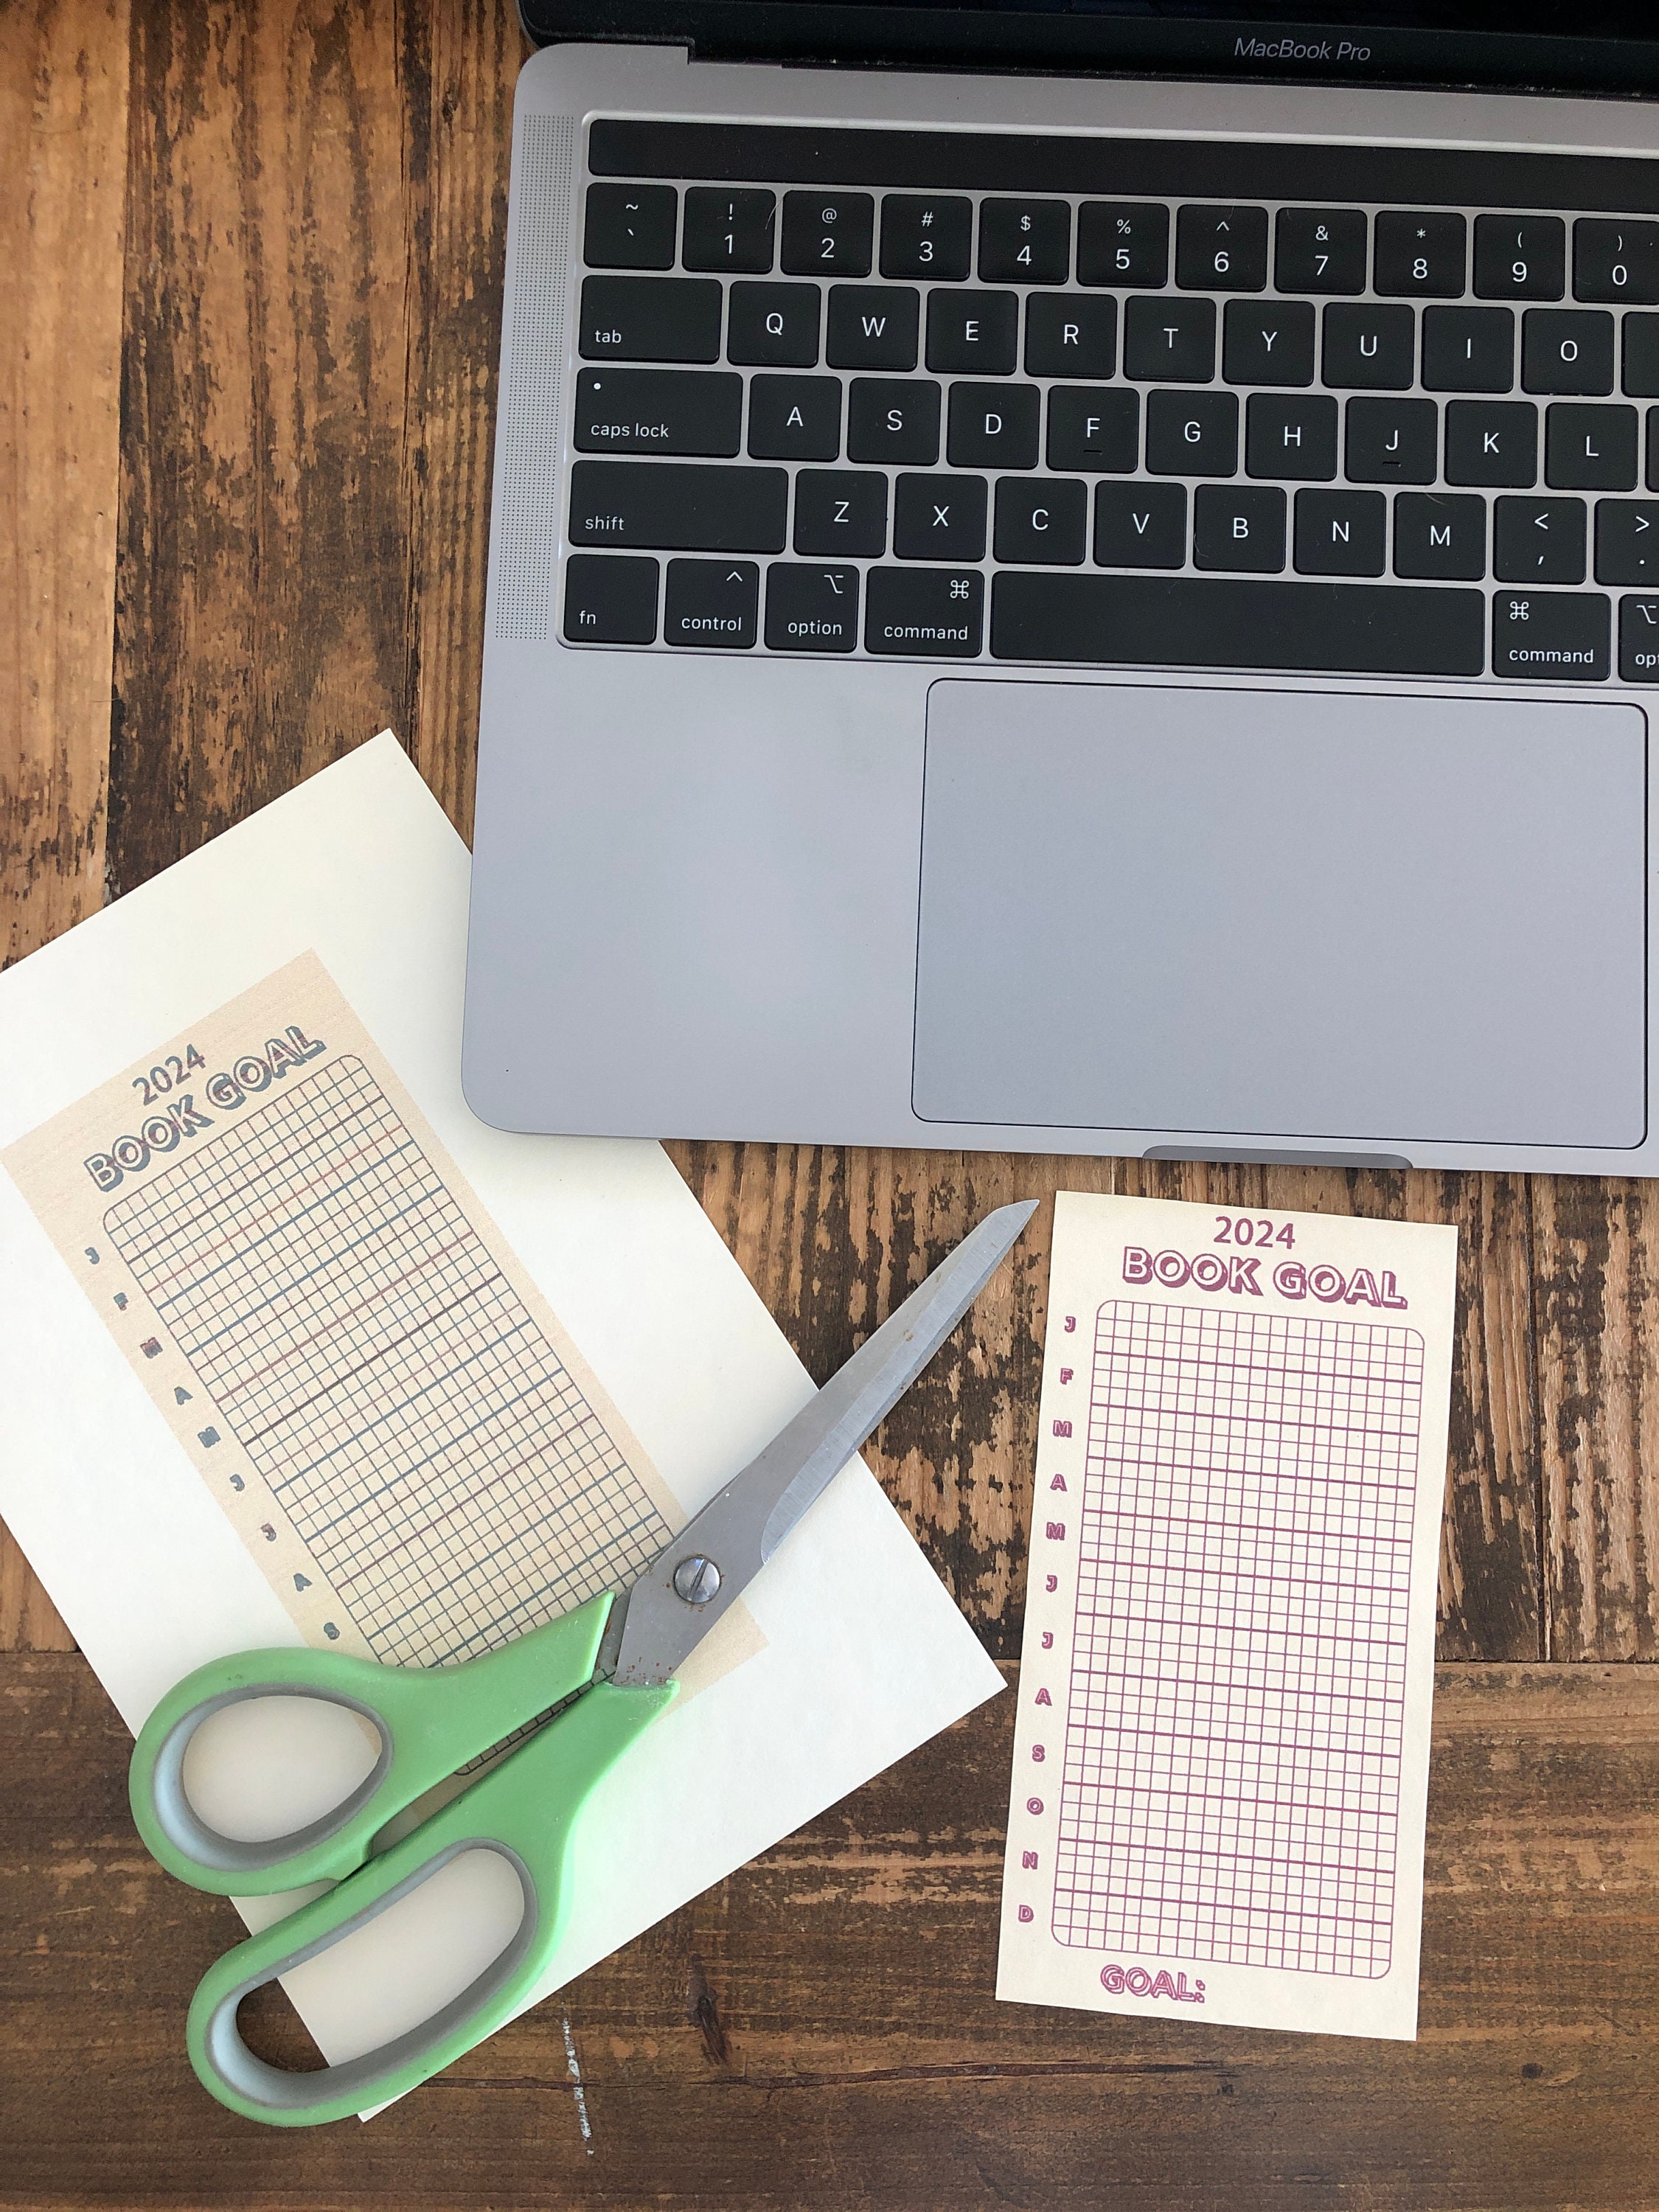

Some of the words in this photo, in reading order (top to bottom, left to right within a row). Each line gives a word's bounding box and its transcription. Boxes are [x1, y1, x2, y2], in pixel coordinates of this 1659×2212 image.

[1234, 37, 1332, 60] MacBook
[1336, 41, 1371, 61] Pro
[821, 208, 838, 224] @
[921, 212, 933, 227] #
[1020, 215, 1031, 232] $
[1116, 219, 1131, 234] %
[1315, 225, 1329, 241] &
[724, 234, 733, 254] 1
[821, 237, 835, 258] 2
[919, 240, 933, 262] 3
[1016, 245, 1032, 265] 4
[1116, 248, 1130, 270] 5
[1214, 251, 1229, 272] 6
[1315, 255, 1329, 276] 7
[1413, 258, 1428, 279] 8
[1512, 261, 1527, 282] 9
[1612, 265, 1627, 285] 0
[766, 313, 783, 335] Q
[861, 316, 886, 338] W
[965, 320, 979, 341] E
[1063, 324, 1079, 345] R
[594, 329, 622, 344] tab
[1163, 327, 1179, 349] T
[1262, 330, 1278, 352] Y
[1360, 335, 1377, 357] U
[1560, 340, 1578, 361] O
[786, 406, 804, 427] A
[886, 409, 902, 431] S
[985, 414, 1002, 434] D
[591, 425, 630, 439] caps
[635, 422, 669, 438] lock
[1087, 417, 1101, 438] F
[1184, 421, 1201, 442] G
[1284, 425, 1301, 447] H
[1385, 429, 1399, 451] J
[1484, 432, 1500, 453] K
[1586, 435, 1599, 456] L
[833, 501, 849, 523] Z
[932, 505, 950, 527] X
[1032, 509, 1048, 531] C
[1534, 513, 1549, 530] <
[585, 515, 625, 531] shift
[1132, 512, 1150, 535] V
[1233, 517, 1249, 538] B
[1332, 521, 1349, 542] N
[1635, 515, 1649, 532] >
[1430, 525, 1450, 546] M
[579, 610, 597, 625] fn
[681, 616, 742, 631] control
[787, 619, 842, 637] option
[884, 625, 968, 640] command
[1509, 648, 1594, 664] command
[132, 1043, 206, 1106] 2024
[83, 1094, 215, 1192] BOOK
[206, 1026, 327, 1110] GOAL
[1213, 1215, 1296, 1250] 2024
[1121, 1245, 1265, 1297] BOOK
[1273, 1261, 1408, 1310] GOAL
[1065, 1316, 1076, 1333] J
[1060, 1368, 1074, 1385] F
[1053, 1420, 1072, 1438] M
[1050, 1474, 1068, 1492] A
[1046, 1522, 1065, 1540] M
[1046, 1575, 1057, 1593] J
[1042, 1632, 1054, 1649] J
[1034, 1688, 1052, 1706] A
[1032, 1745, 1045, 1762] S
[1026, 1798, 1044, 1815] O
[1022, 1851, 1038, 1870] N
[1018, 1905, 1034, 1923] D
[1099, 1963, 1206, 2003] GOAL:
